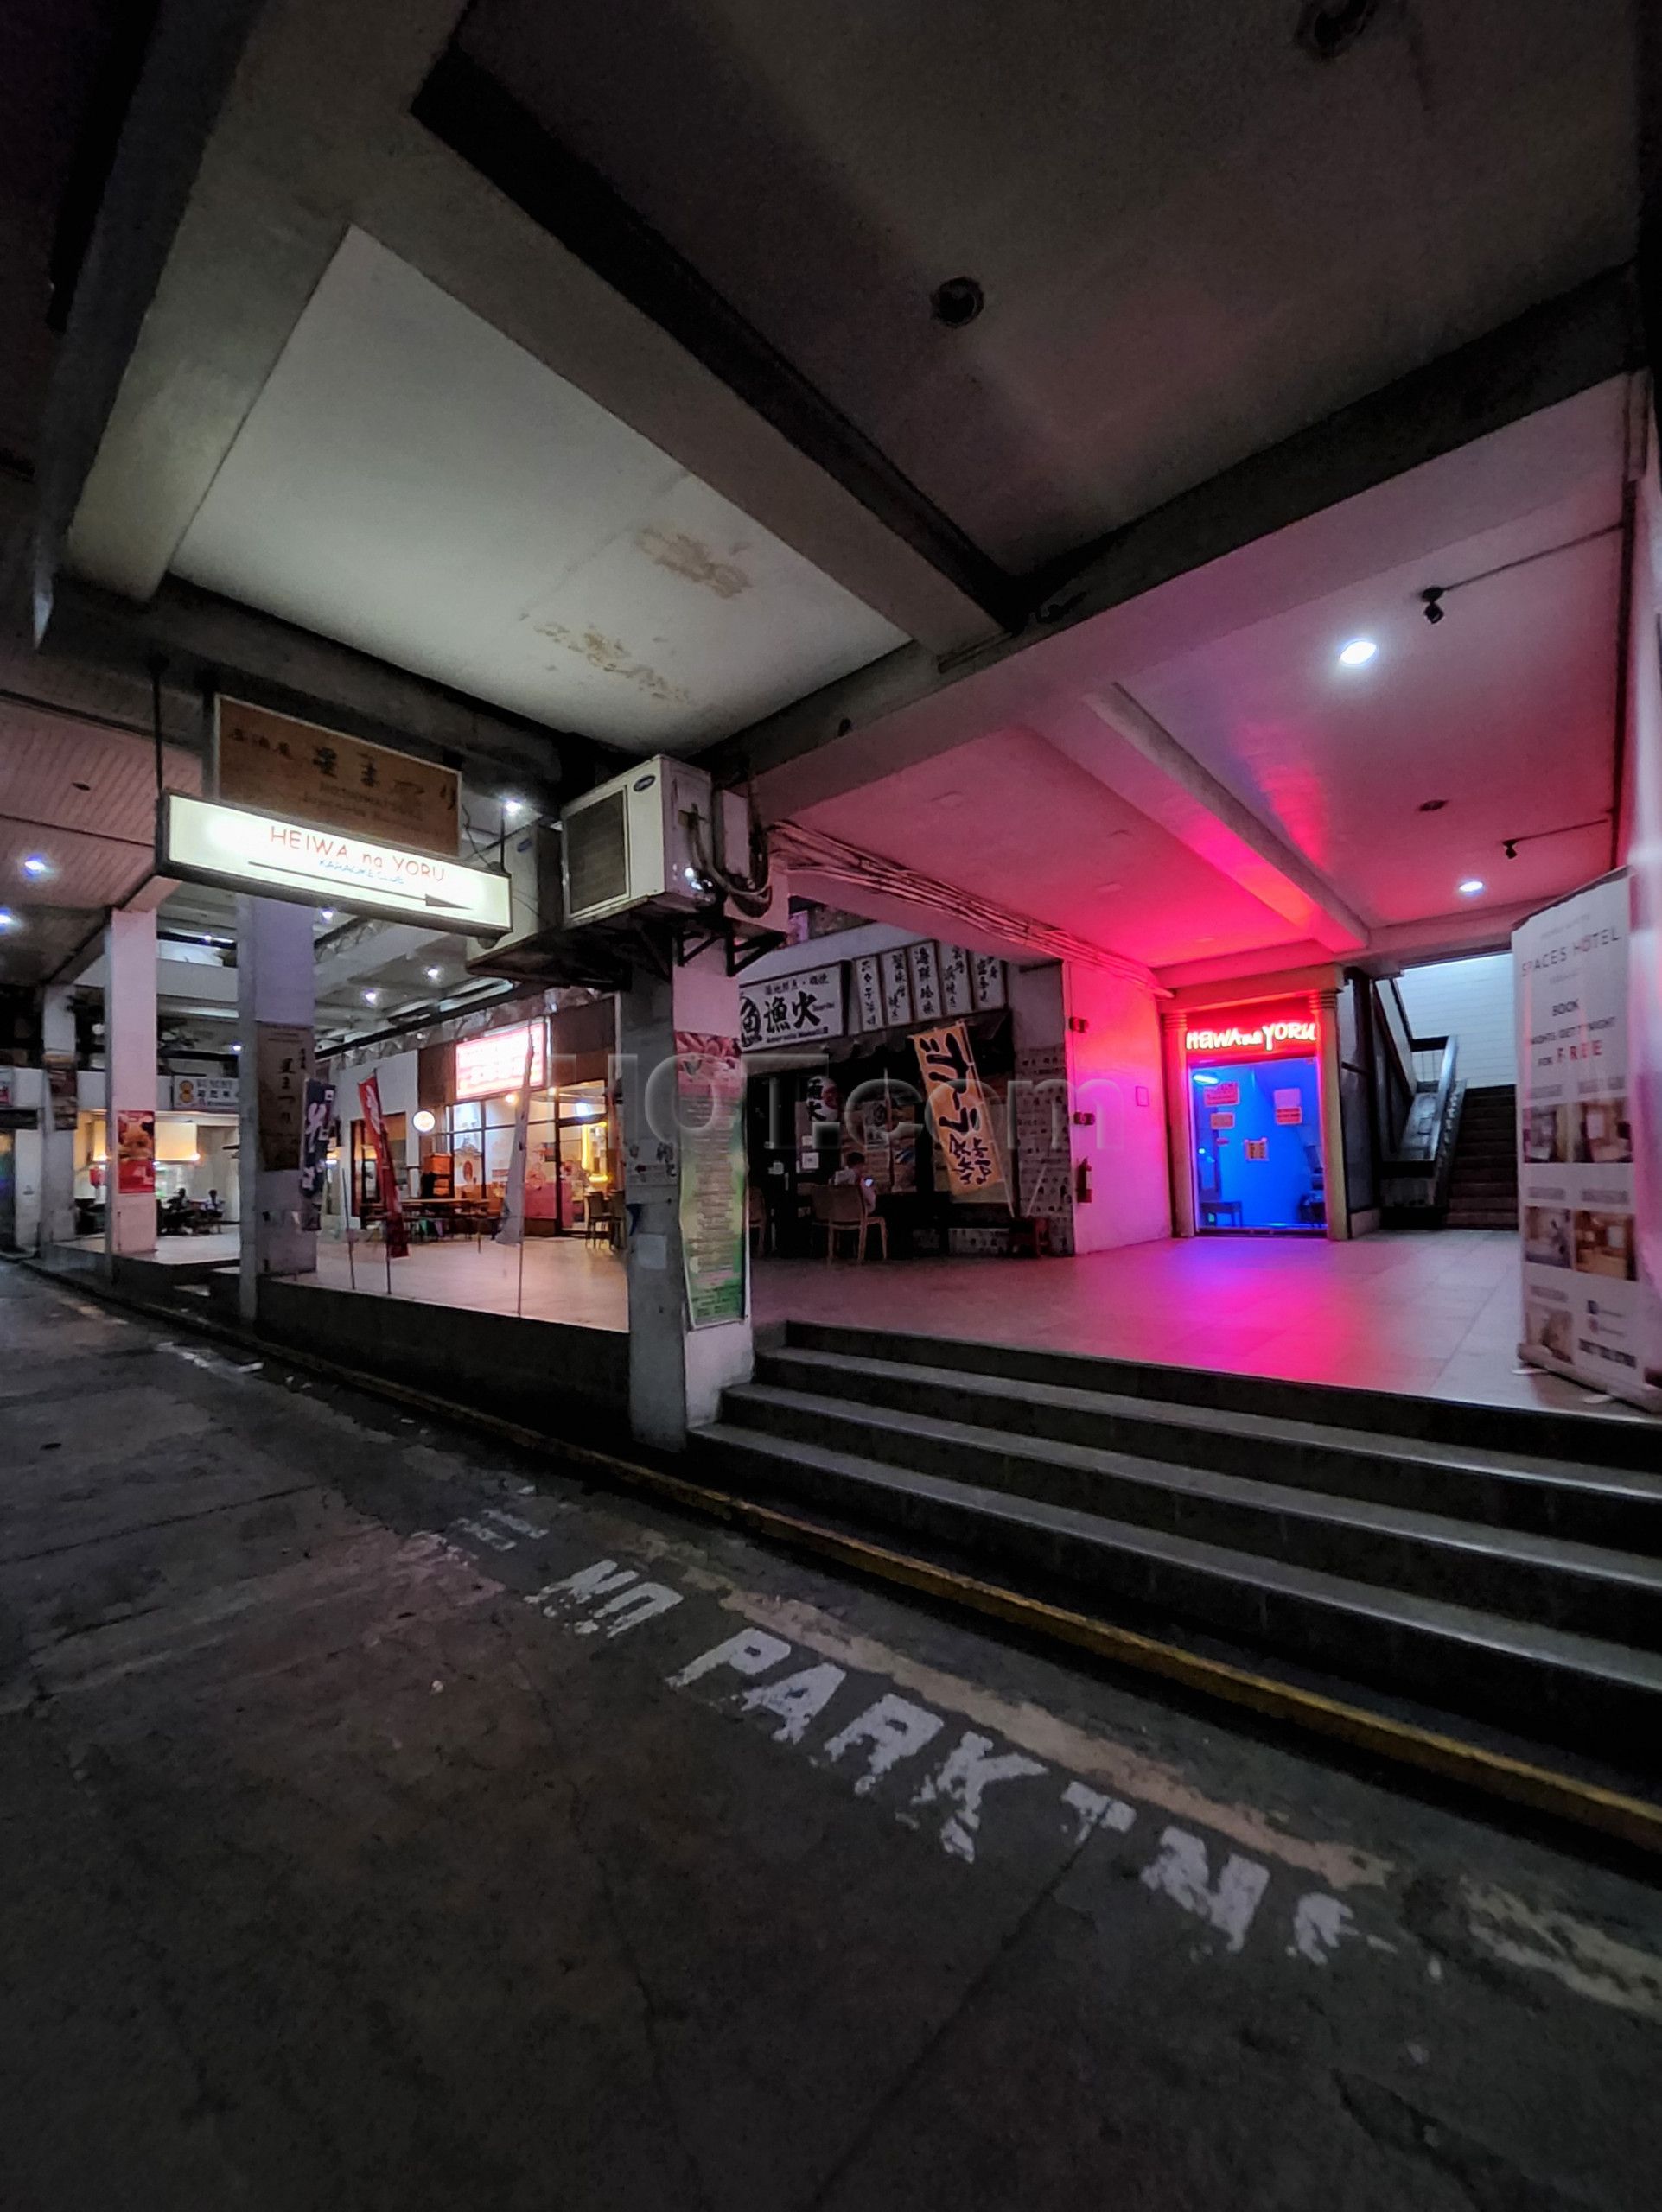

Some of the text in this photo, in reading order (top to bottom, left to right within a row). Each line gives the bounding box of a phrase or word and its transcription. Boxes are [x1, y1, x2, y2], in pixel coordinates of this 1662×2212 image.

[271, 824, 349, 858] HEIWA
[392, 855, 446, 882] YORU
[1521, 946, 1568, 977] SPACES
[1573, 925, 1621, 955] HOTEL
[762, 990, 822, 1034] 漁火
[1263, 1022, 1316, 1052] YORU
[1557, 1039, 1603, 1064] FREE
[522, 1559, 685, 1640] NO
